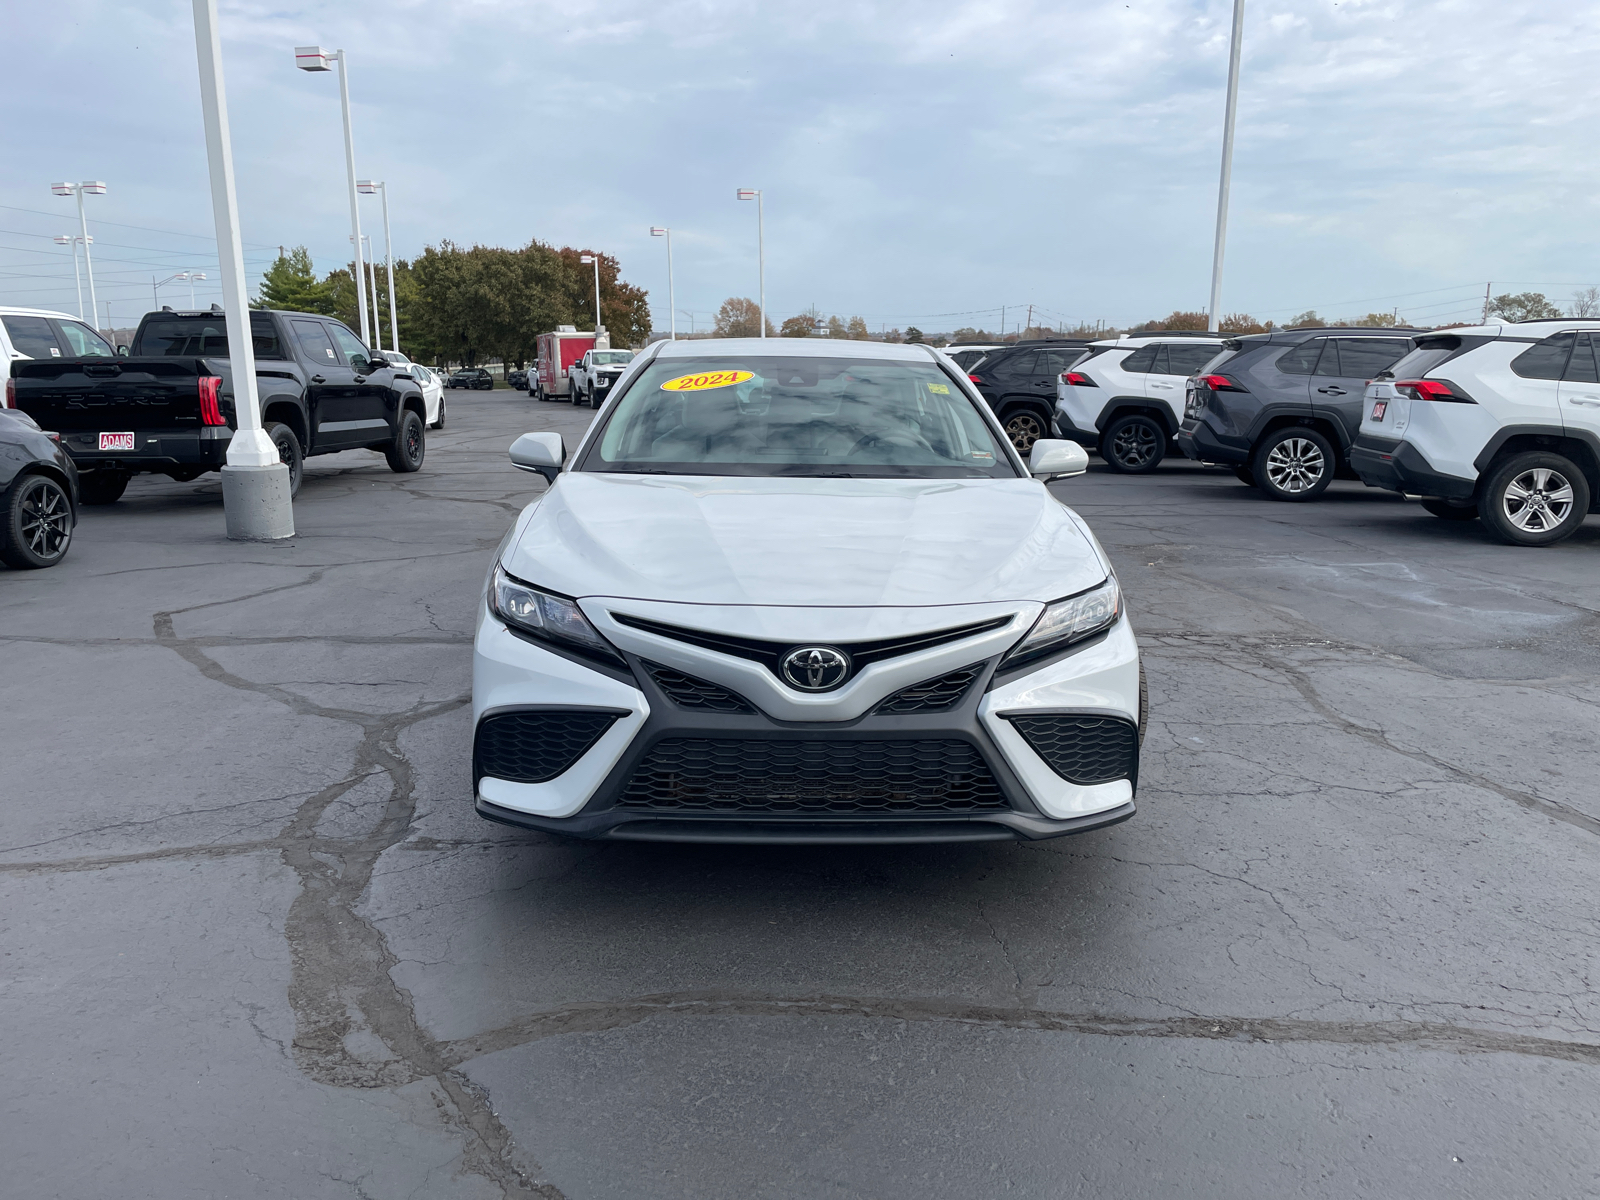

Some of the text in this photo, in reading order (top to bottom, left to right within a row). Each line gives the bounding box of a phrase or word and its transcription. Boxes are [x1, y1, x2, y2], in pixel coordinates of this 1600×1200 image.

[678, 372, 739, 389] 2024
[110, 396, 170, 406] PRO
[101, 434, 132, 448] ADAMS
